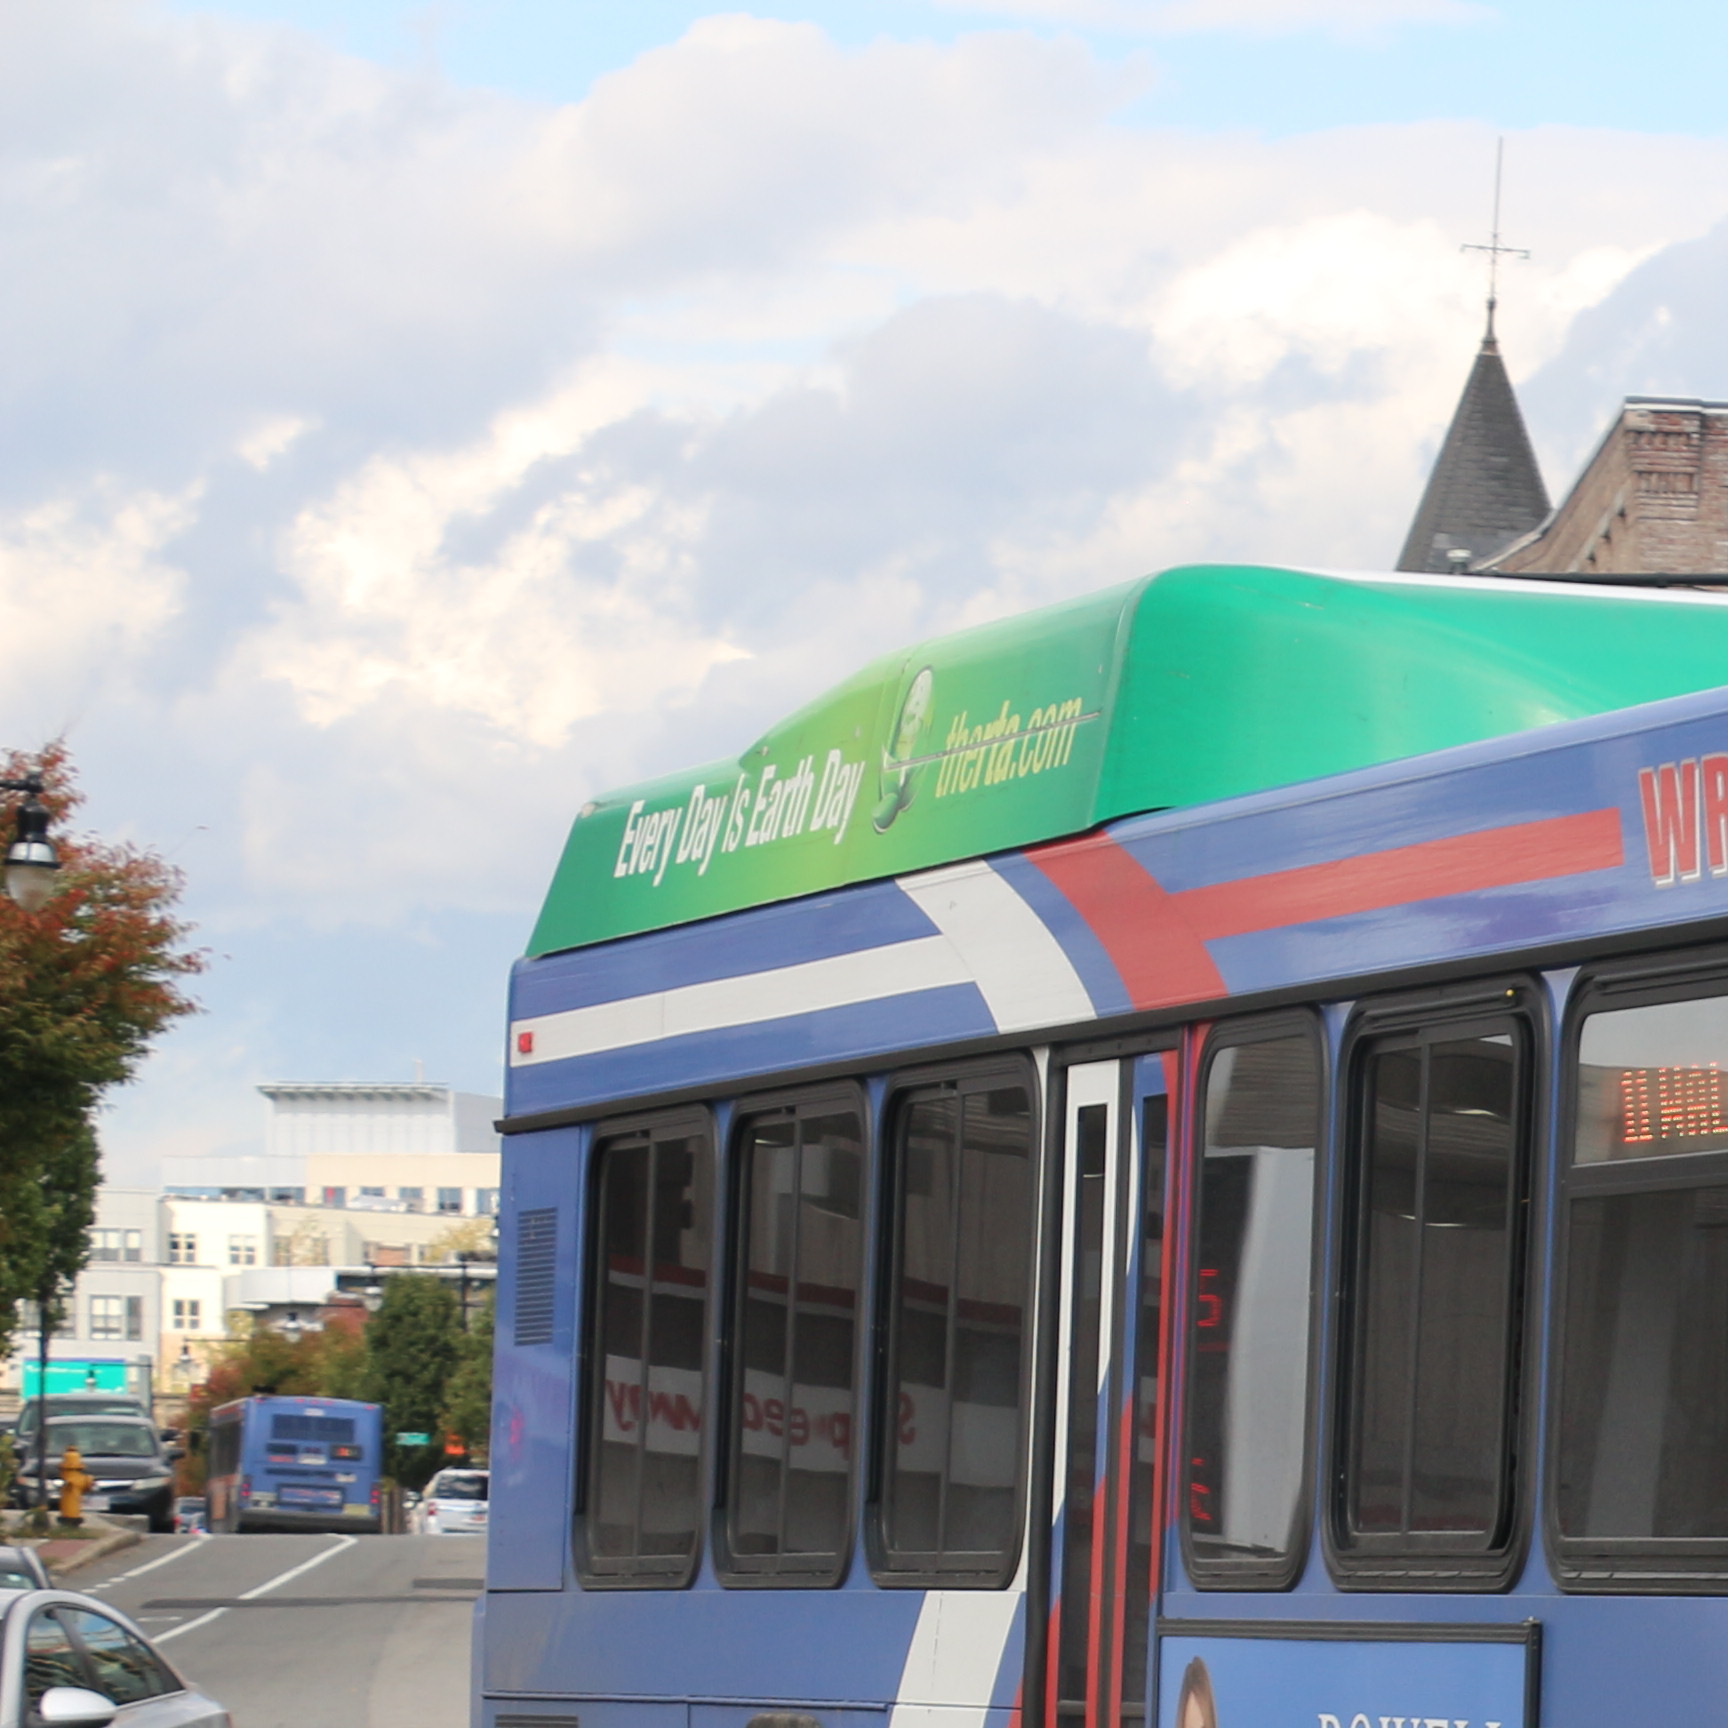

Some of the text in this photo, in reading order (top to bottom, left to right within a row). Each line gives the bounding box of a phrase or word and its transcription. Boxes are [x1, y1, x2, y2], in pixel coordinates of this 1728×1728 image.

[934, 697, 1083, 798] therta.com
[613, 800, 681, 887] Every
[675, 784, 728, 877] Day
[744, 754, 816, 847] Earth
[809, 748, 866, 844] Day
